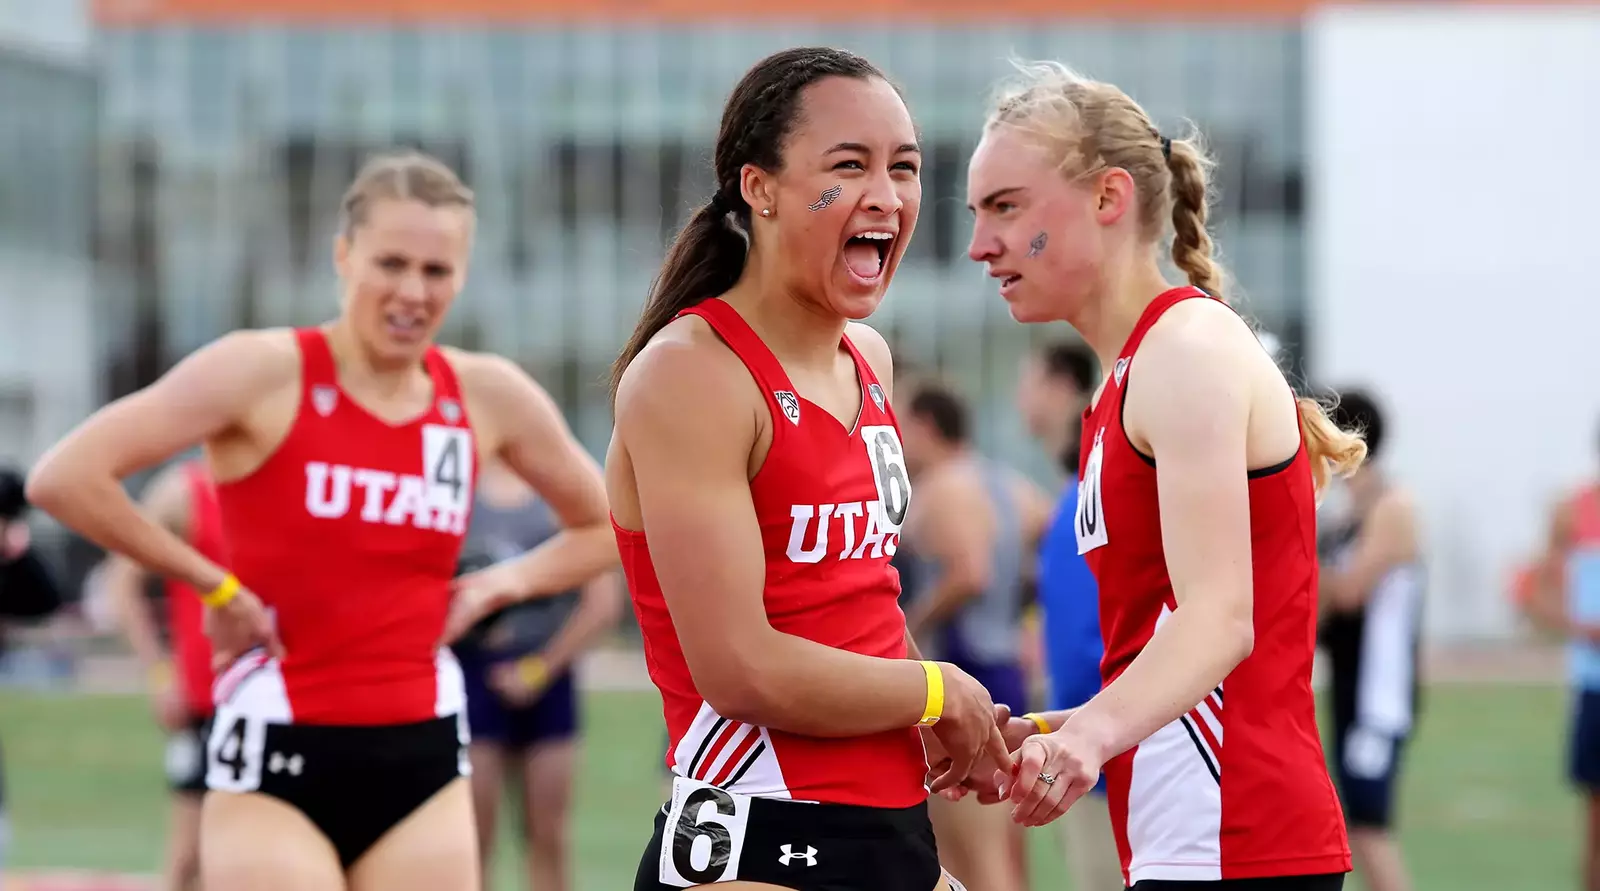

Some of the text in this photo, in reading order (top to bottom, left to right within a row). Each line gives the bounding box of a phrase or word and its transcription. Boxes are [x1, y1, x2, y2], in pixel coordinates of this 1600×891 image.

[783, 405, 798, 418] 12
[435, 437, 462, 502] 4
[874, 431, 908, 526] 6
[1080, 463, 1096, 537] 10
[217, 716, 247, 781] 4
[672, 787, 736, 884] 6
